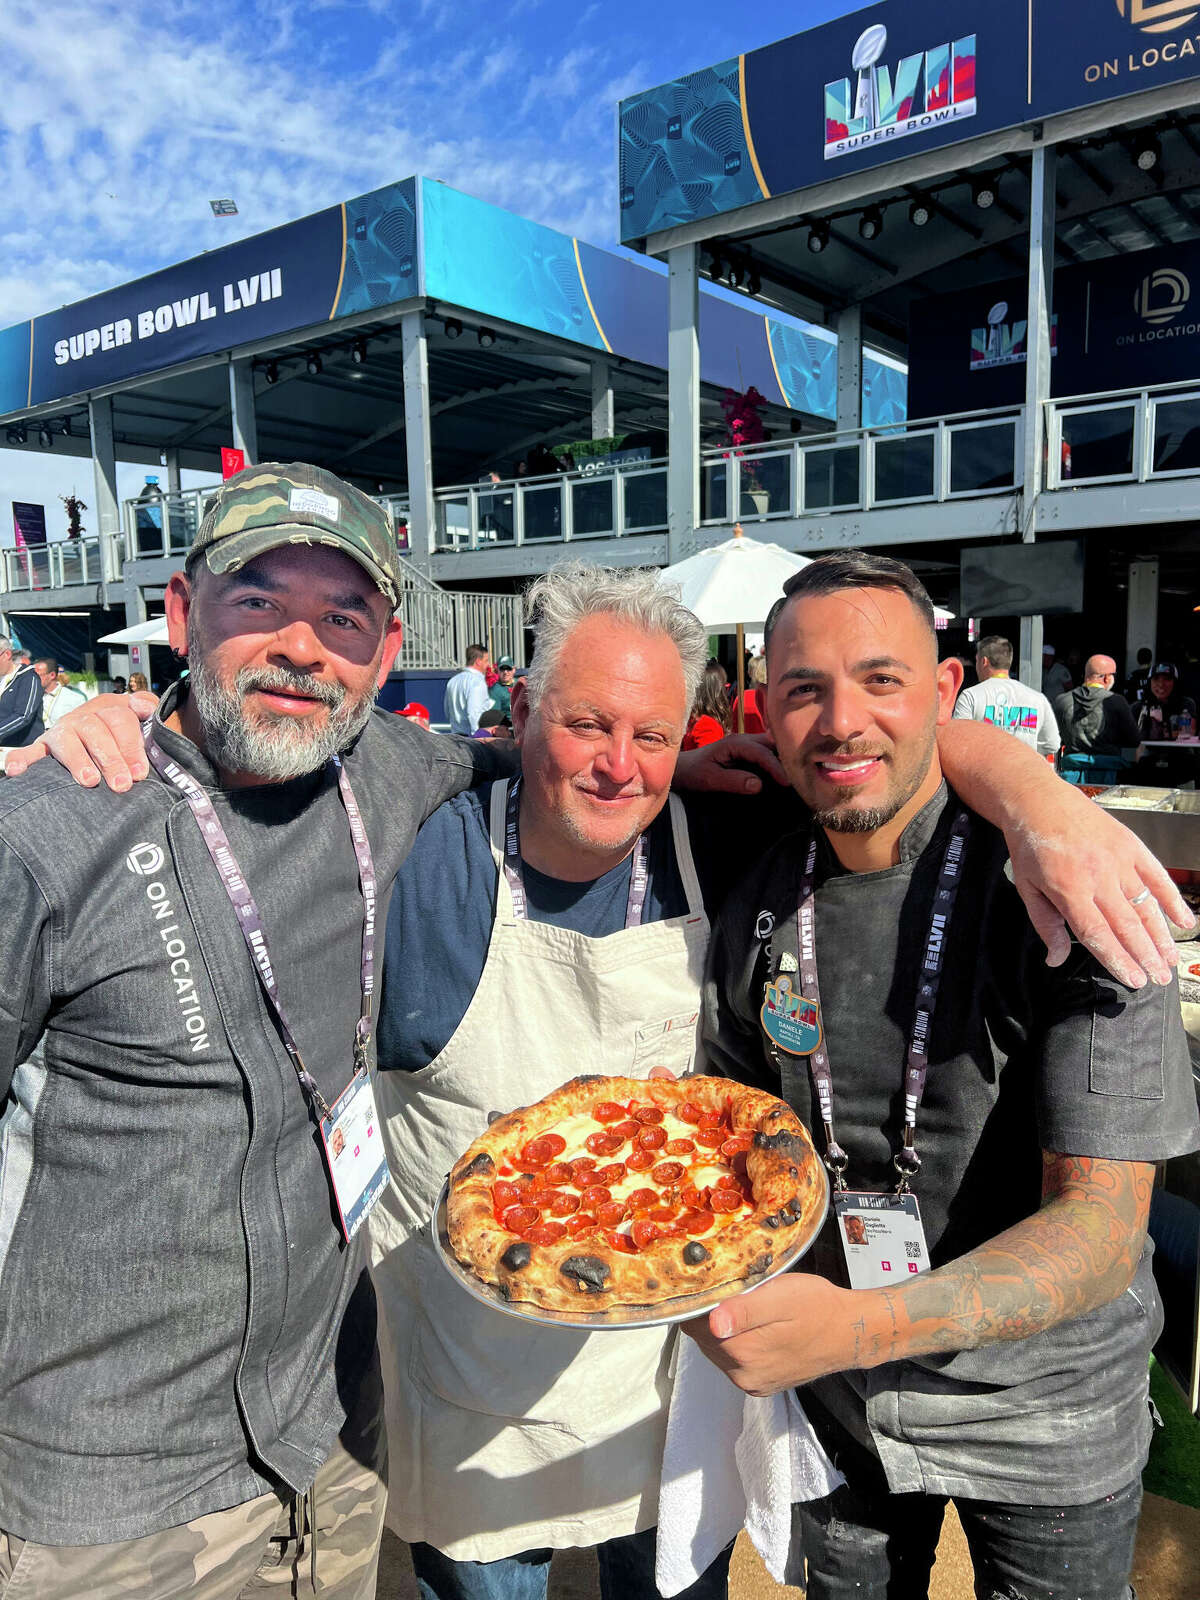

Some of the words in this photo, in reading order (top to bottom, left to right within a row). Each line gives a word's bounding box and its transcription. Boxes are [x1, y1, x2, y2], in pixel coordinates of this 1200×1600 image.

[824, 34, 977, 145] LVII
[1084, 58, 1119, 82] ON
[836, 127, 896, 152] SUPER
[907, 107, 962, 130] BOWL
[54, 318, 132, 366] SUPER
[137, 291, 217, 340] BOWL
[223, 267, 282, 313] LVII
[1115, 334, 1135, 346] ON
[146, 881, 174, 920] ON
[249, 929, 271, 970] LVII
[801, 925, 813, 960] LVII
[927, 913, 947, 952] LVII
[159, 924, 210, 1052] LOCATION
[911, 1009, 930, 1055] NON-STADIUM
